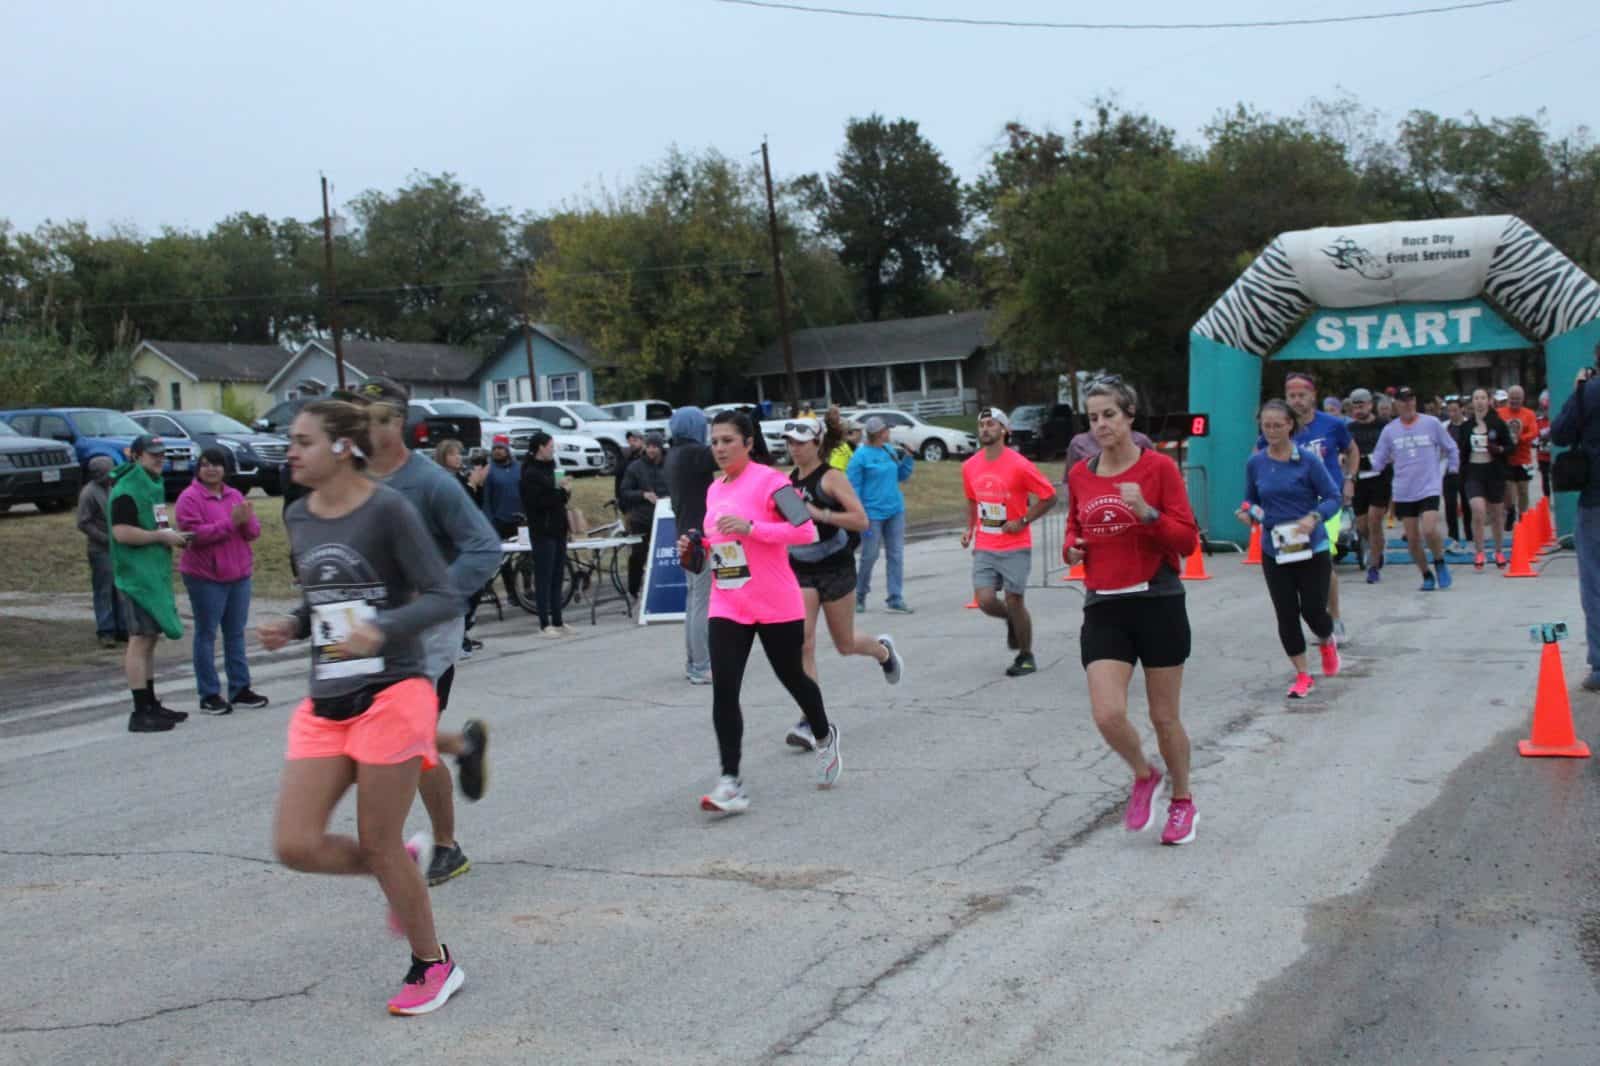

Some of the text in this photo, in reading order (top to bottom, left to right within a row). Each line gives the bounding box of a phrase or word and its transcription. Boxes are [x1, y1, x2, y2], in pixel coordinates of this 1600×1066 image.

[1402, 234, 1455, 246] Race Day
[1387, 249, 1470, 264] Event Services
[1315, 307, 1482, 352] START
